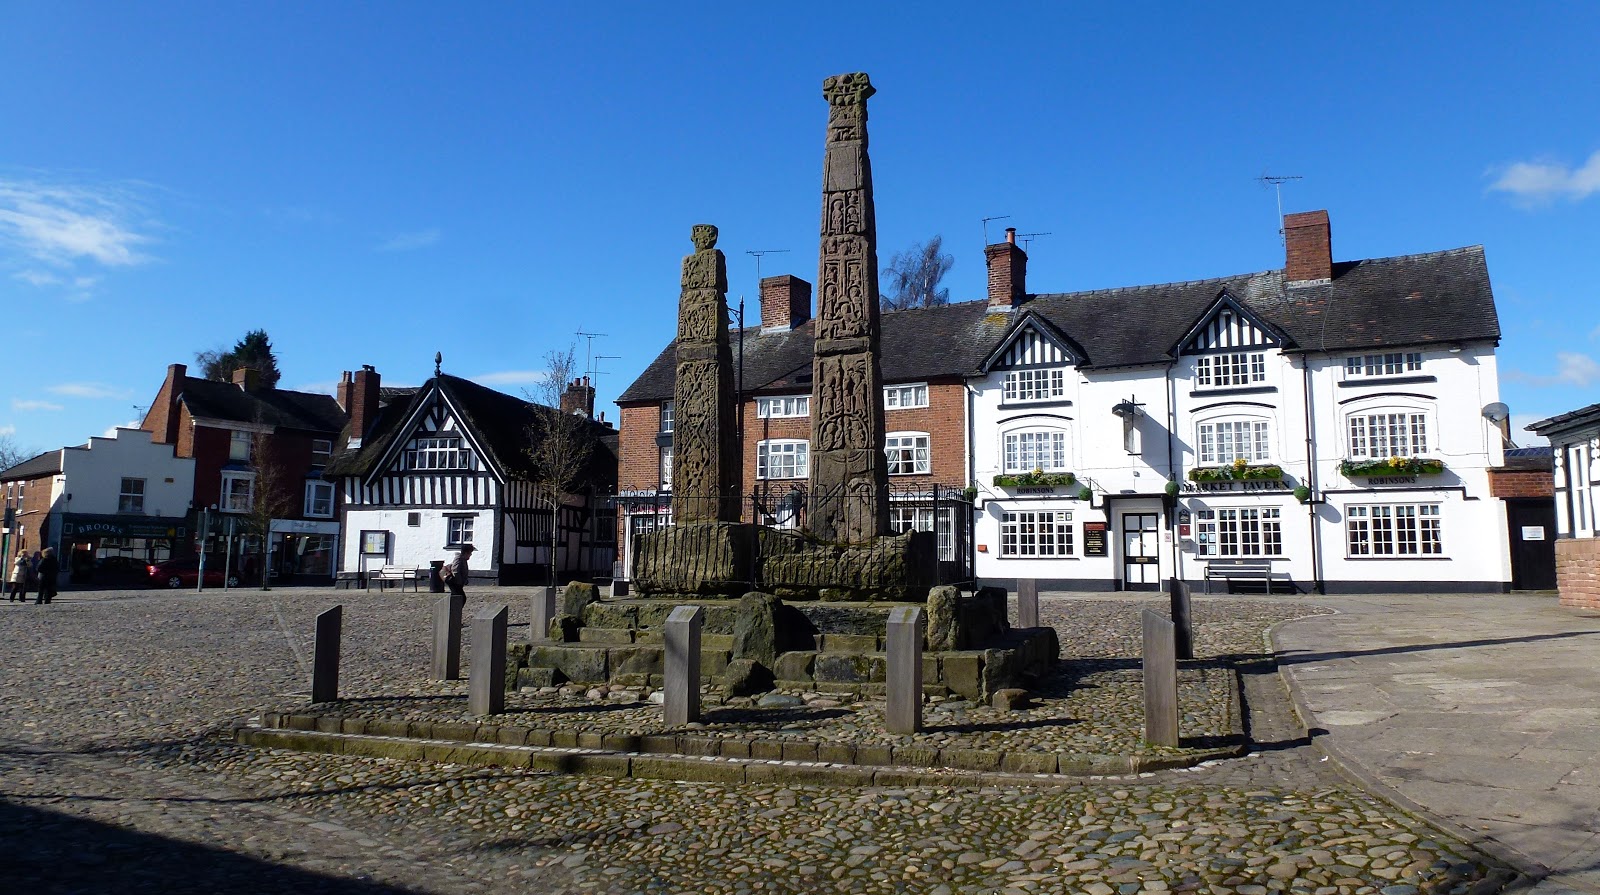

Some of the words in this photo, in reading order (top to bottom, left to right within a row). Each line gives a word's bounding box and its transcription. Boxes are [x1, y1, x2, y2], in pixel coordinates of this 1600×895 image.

[1368, 476, 1416, 485] ROBINSONS
[1017, 487, 1053, 495] ROBINSONS
[1181, 481, 1234, 492] MARKET
[1241, 480, 1290, 490] TAVERN
[79, 523, 123, 534] BROOKS
